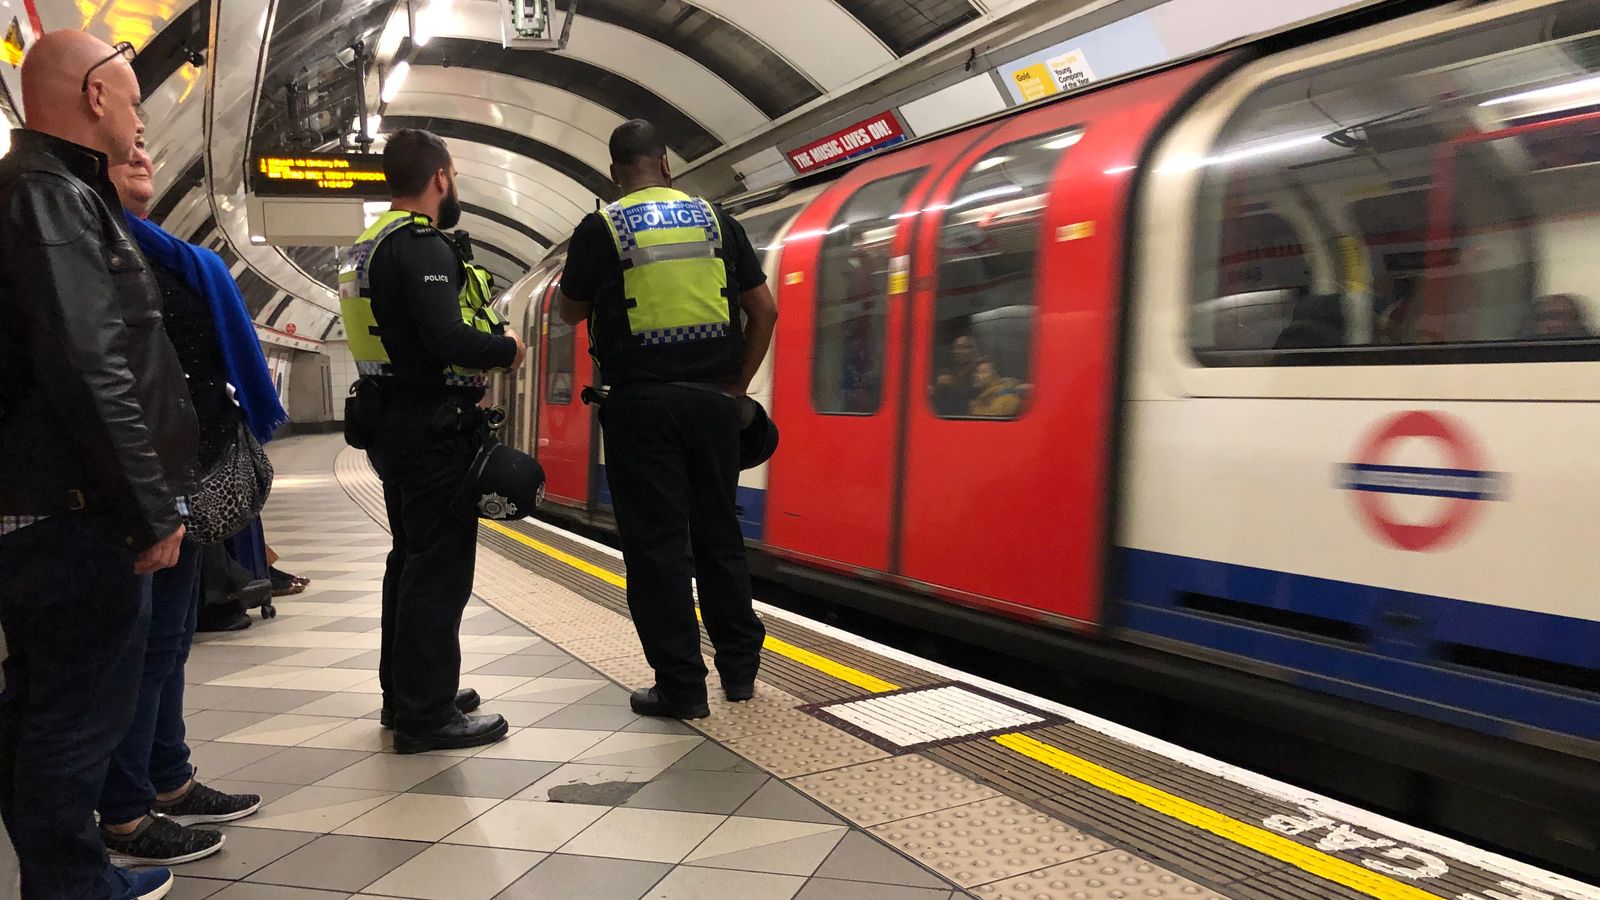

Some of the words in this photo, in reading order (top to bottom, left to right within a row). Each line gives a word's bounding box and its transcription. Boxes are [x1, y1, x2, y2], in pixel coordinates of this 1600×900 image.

[1016, 72, 1031, 82] Gold
[1054, 66, 1072, 77] Young
[1058, 71, 1084, 83] Company
[1068, 81, 1078, 90] the
[1077, 78, 1089, 87] Year
[792, 152, 814, 169] THE
[808, 139, 844, 163] MUSIC
[839, 127, 872, 151] LIVES
[867, 119, 893, 140] ON!
[628, 209, 705, 228] POLICE
[424, 274, 449, 283] POLICE
